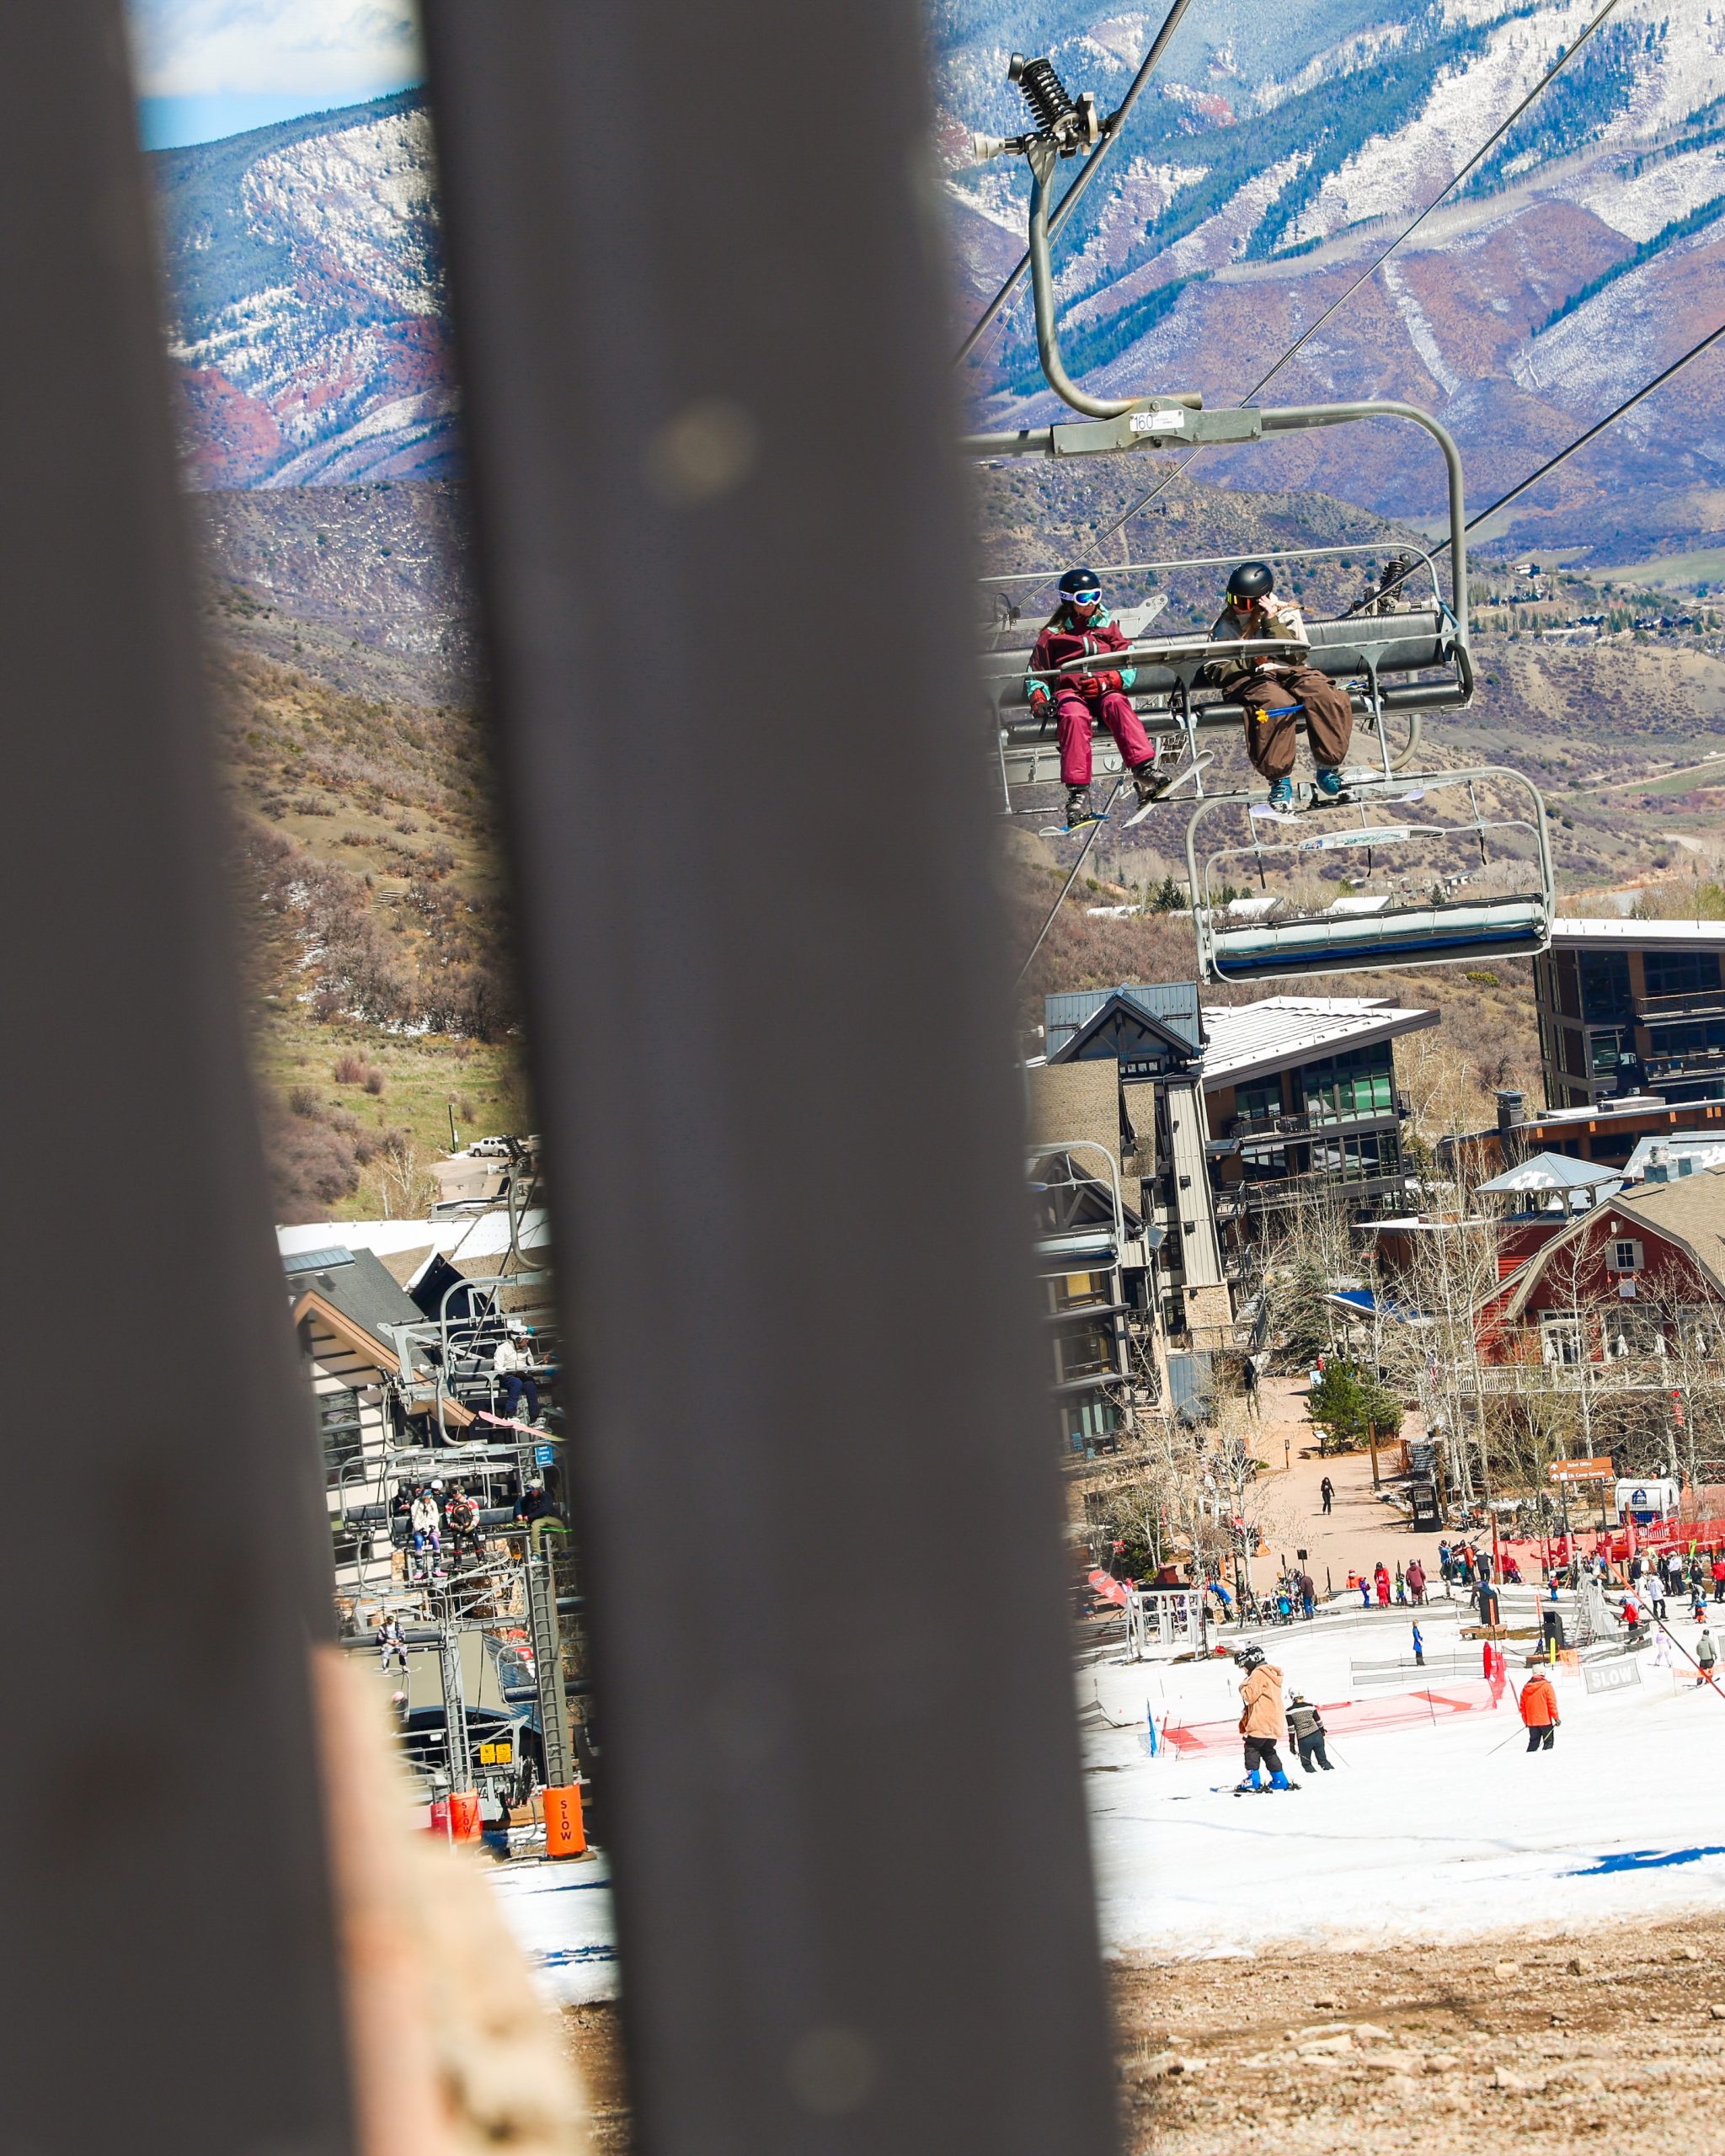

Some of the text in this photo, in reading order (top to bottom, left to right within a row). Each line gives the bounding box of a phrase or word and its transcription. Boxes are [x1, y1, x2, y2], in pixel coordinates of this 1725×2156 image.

[1134, 414, 1153, 430] 160
[1590, 1666, 1632, 1689] SLOW
[462, 1801, 472, 1833] SLOW
[561, 1800, 572, 1841] SLOW
